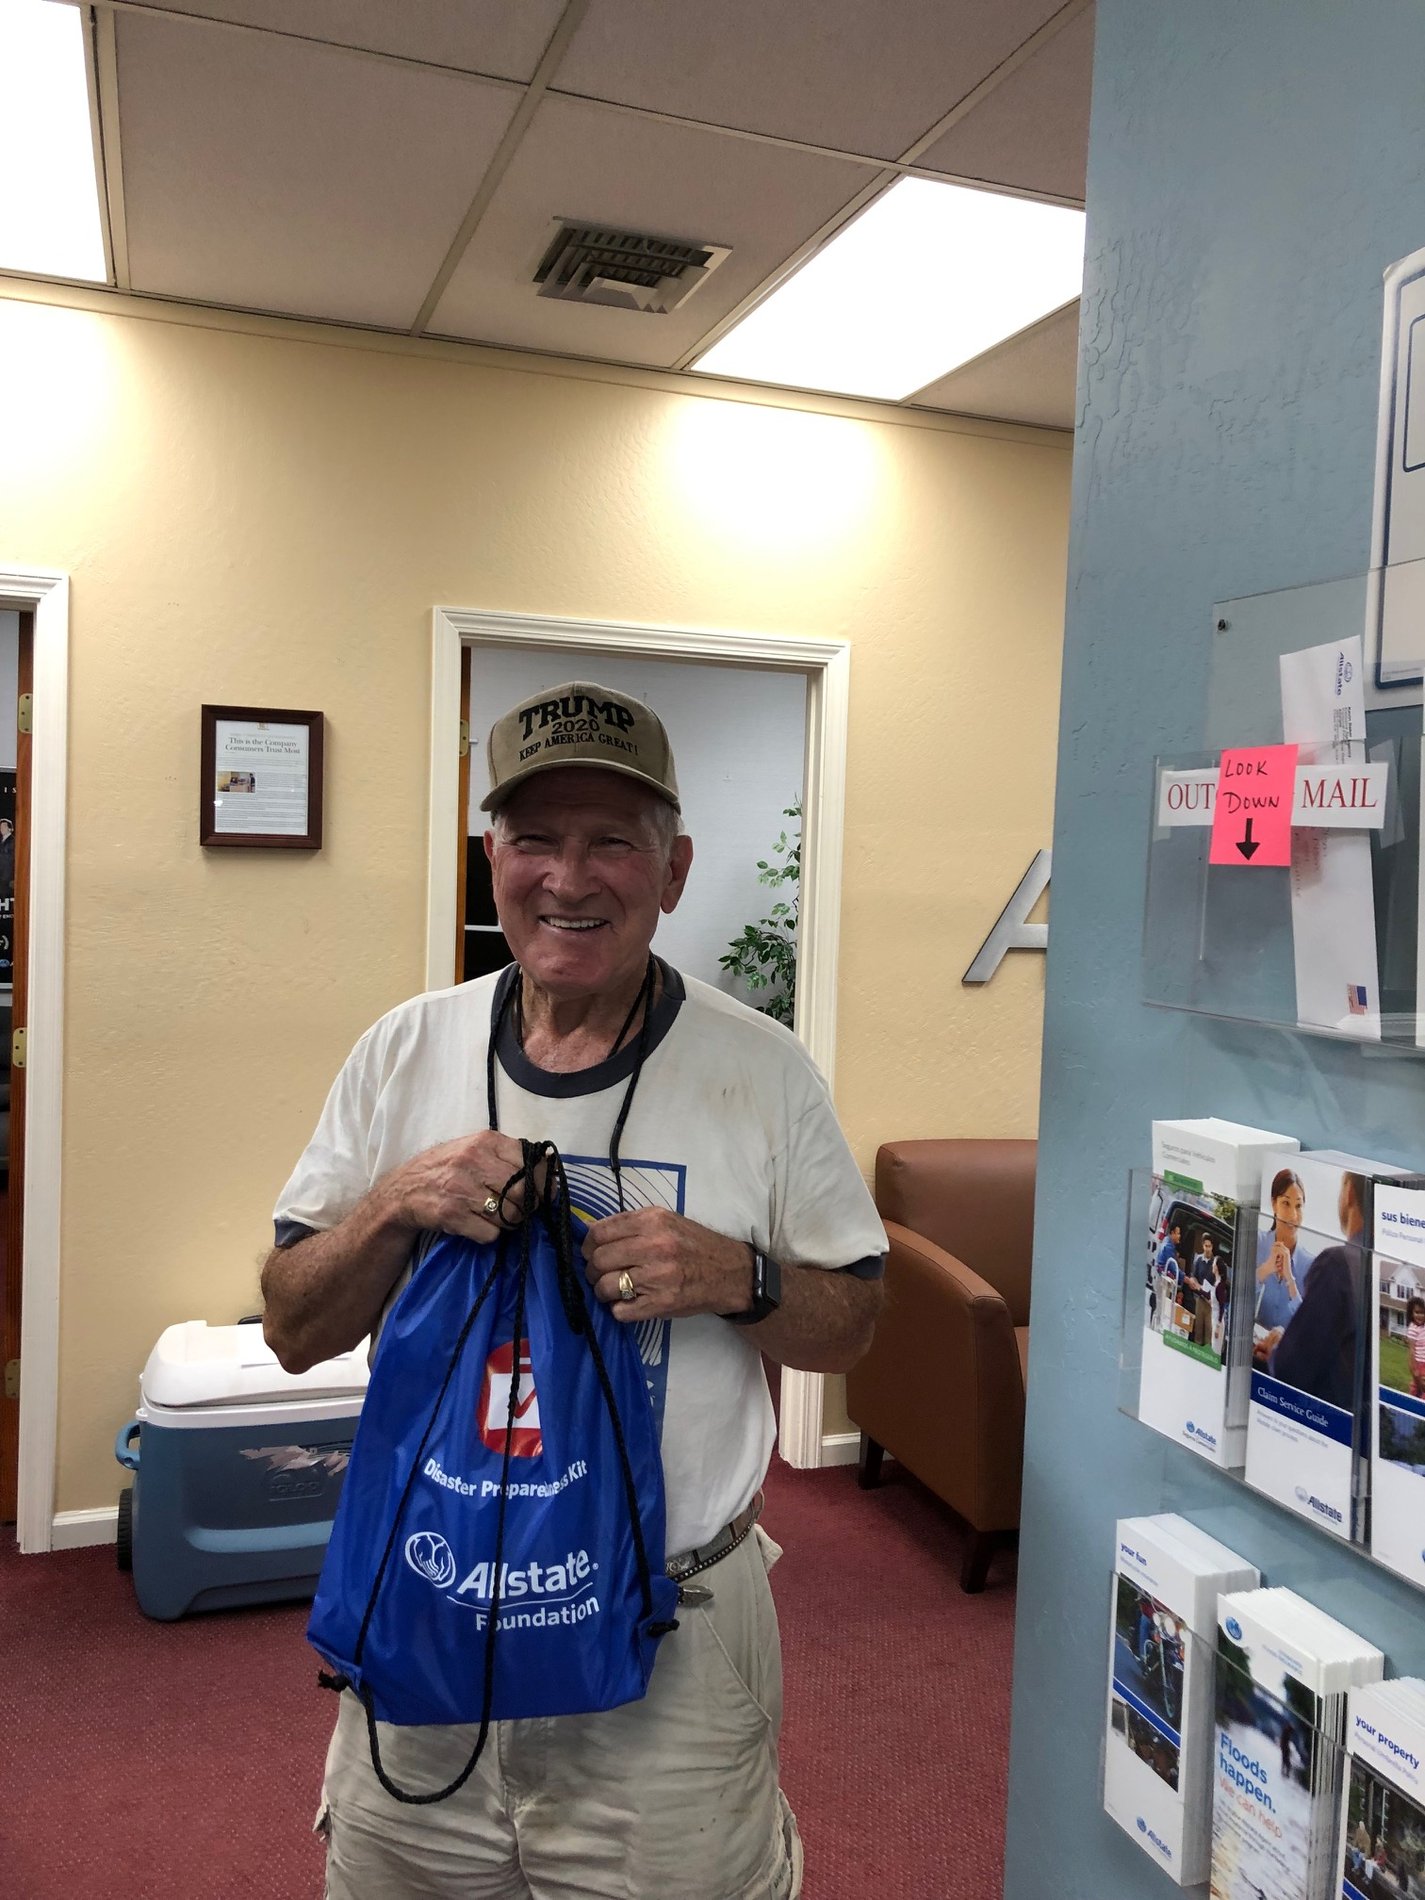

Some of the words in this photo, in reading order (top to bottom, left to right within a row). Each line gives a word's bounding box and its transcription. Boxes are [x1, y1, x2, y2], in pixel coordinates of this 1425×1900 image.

[518, 696, 635, 741] TRUMP
[551, 719, 600, 735] 2020
[225, 744, 264, 752] Consumers
[266, 745, 283, 753] Trust
[252, 737, 263, 745] the
[265, 739, 297, 748] Company
[519, 742, 541, 761] KEEP
[545, 732, 594, 748] AMERICA
[598, 734, 639, 756] GREAT!
[1225, 759, 1268, 777] LOOK
[1167, 783, 1218, 810] OUT
[1301, 777, 1379, 809] MAIL
[1223, 791, 1280, 814] DOWN
[1381, 1211, 1398, 1223] sus
[1257, 1386, 1278, 1404] Claim
[1279, 1396, 1306, 1416] Service
[1305, 1409, 1329, 1428] Guide
[423, 1458, 477, 1497] Disaster
[567, 1459, 588, 1483] Kit
[1307, 1495, 1343, 1523] Allstate
[1120, 1542, 1135, 1557] your
[1355, 1715, 1377, 1736] your
[1378, 1732, 1420, 1770] property
[1220, 1731, 1268, 1784] Floods
[1219, 1752, 1277, 1814] happen.
